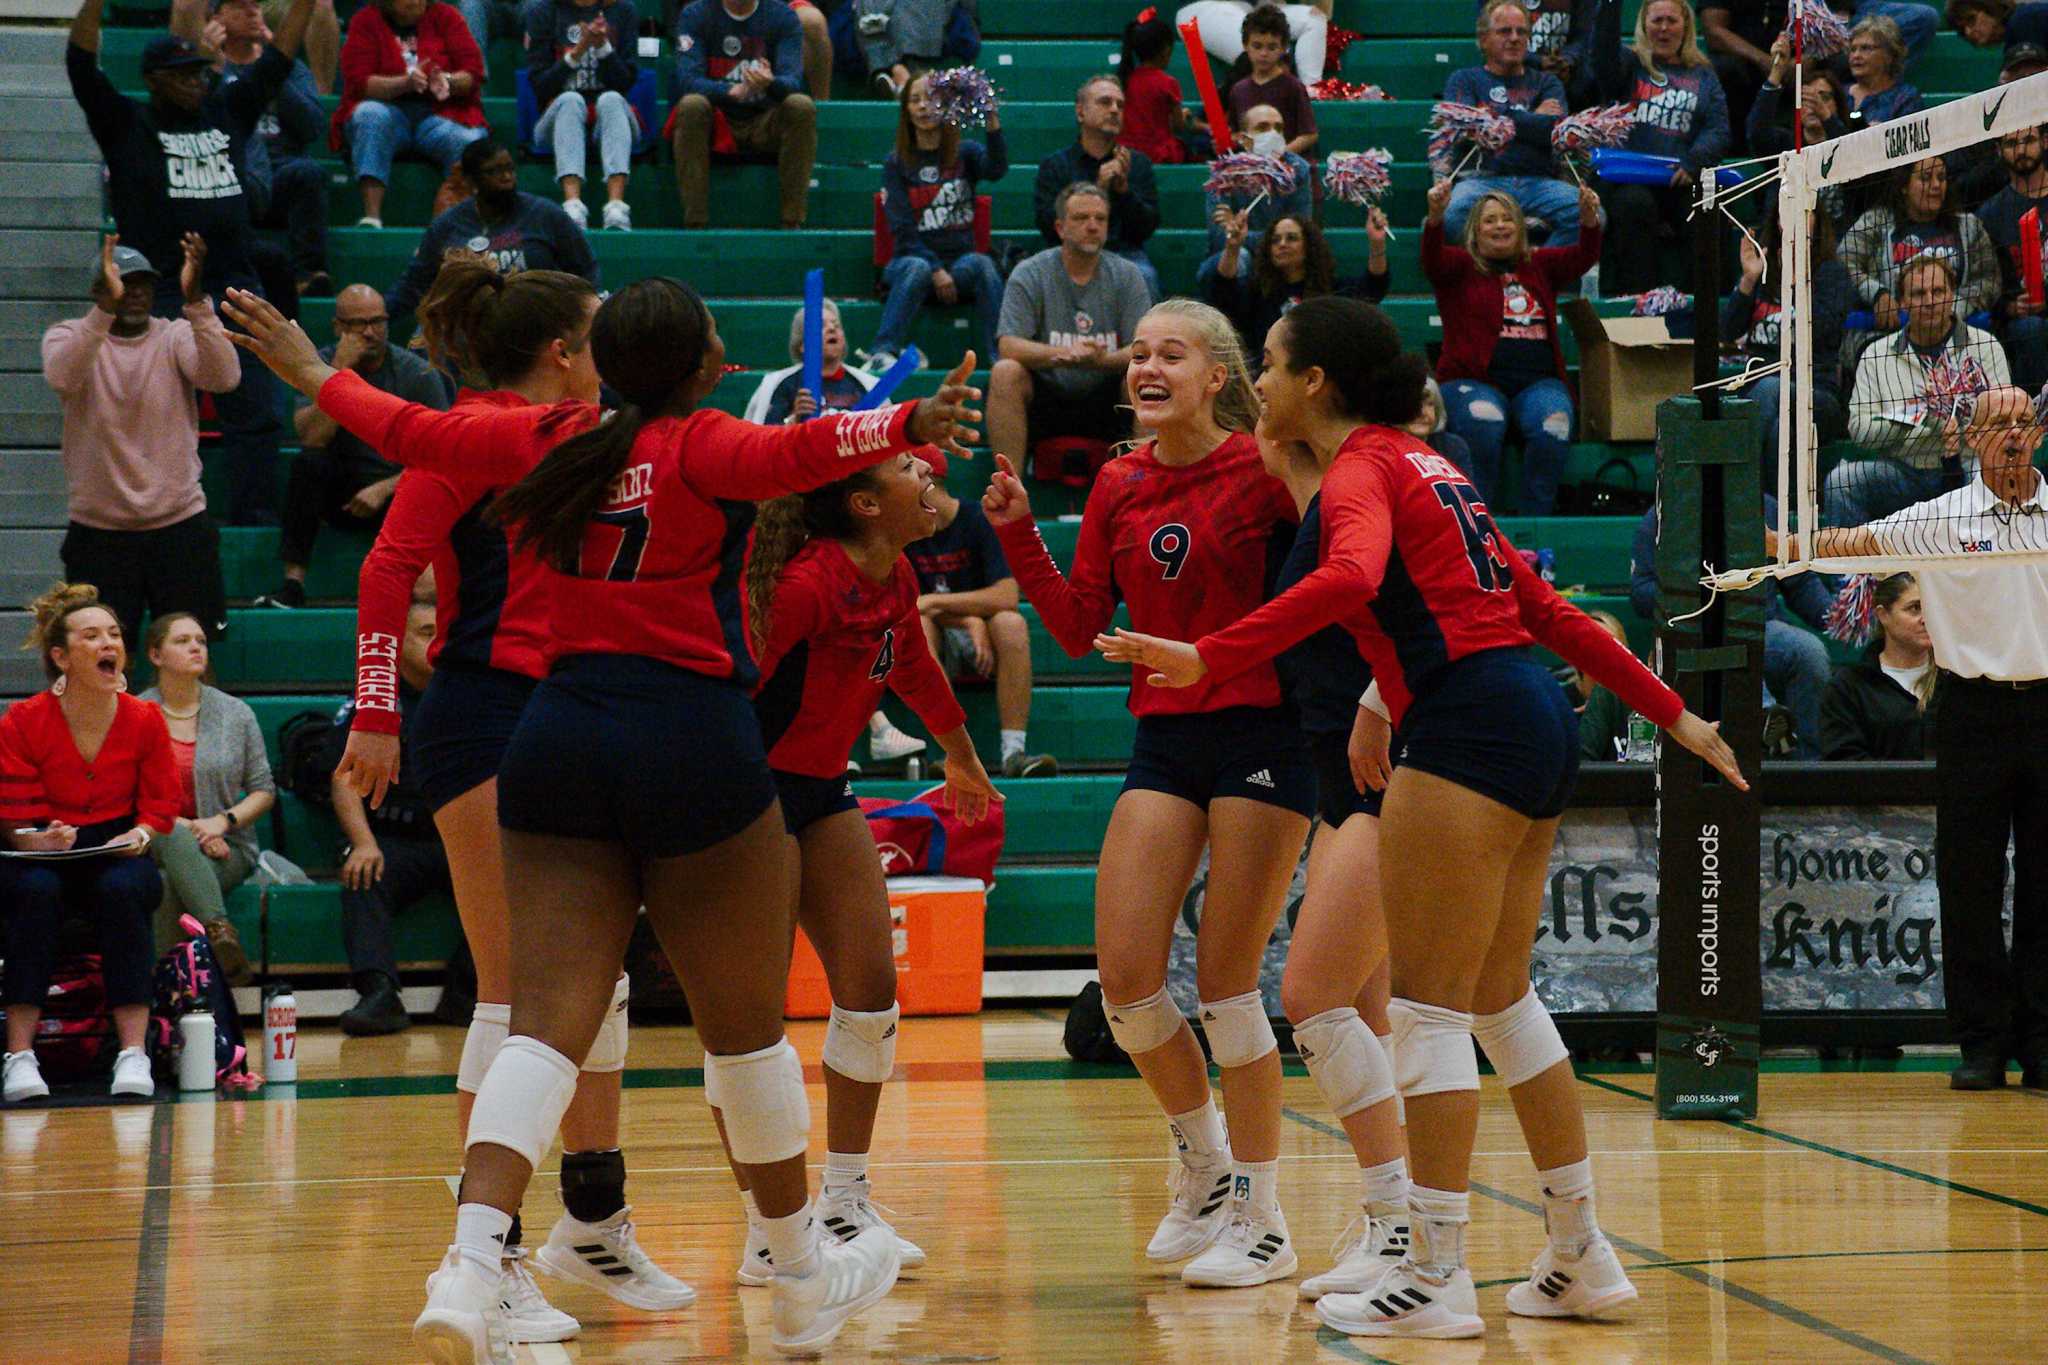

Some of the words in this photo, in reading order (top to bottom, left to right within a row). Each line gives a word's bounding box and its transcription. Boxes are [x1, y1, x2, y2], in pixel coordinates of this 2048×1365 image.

[606, 463, 653, 505] SON
[1149, 522, 1191, 580] 9
[1430, 480, 1514, 592] 15
[355, 632, 398, 712] EAGLES
[868, 628, 896, 683] 4
[1697, 823, 1722, 900] sports
[1774, 833, 1890, 889] home
[1534, 866, 1651, 943] lls
[273, 1032, 296, 1060] 17
[1676, 1094, 1698, 1104] (800)
